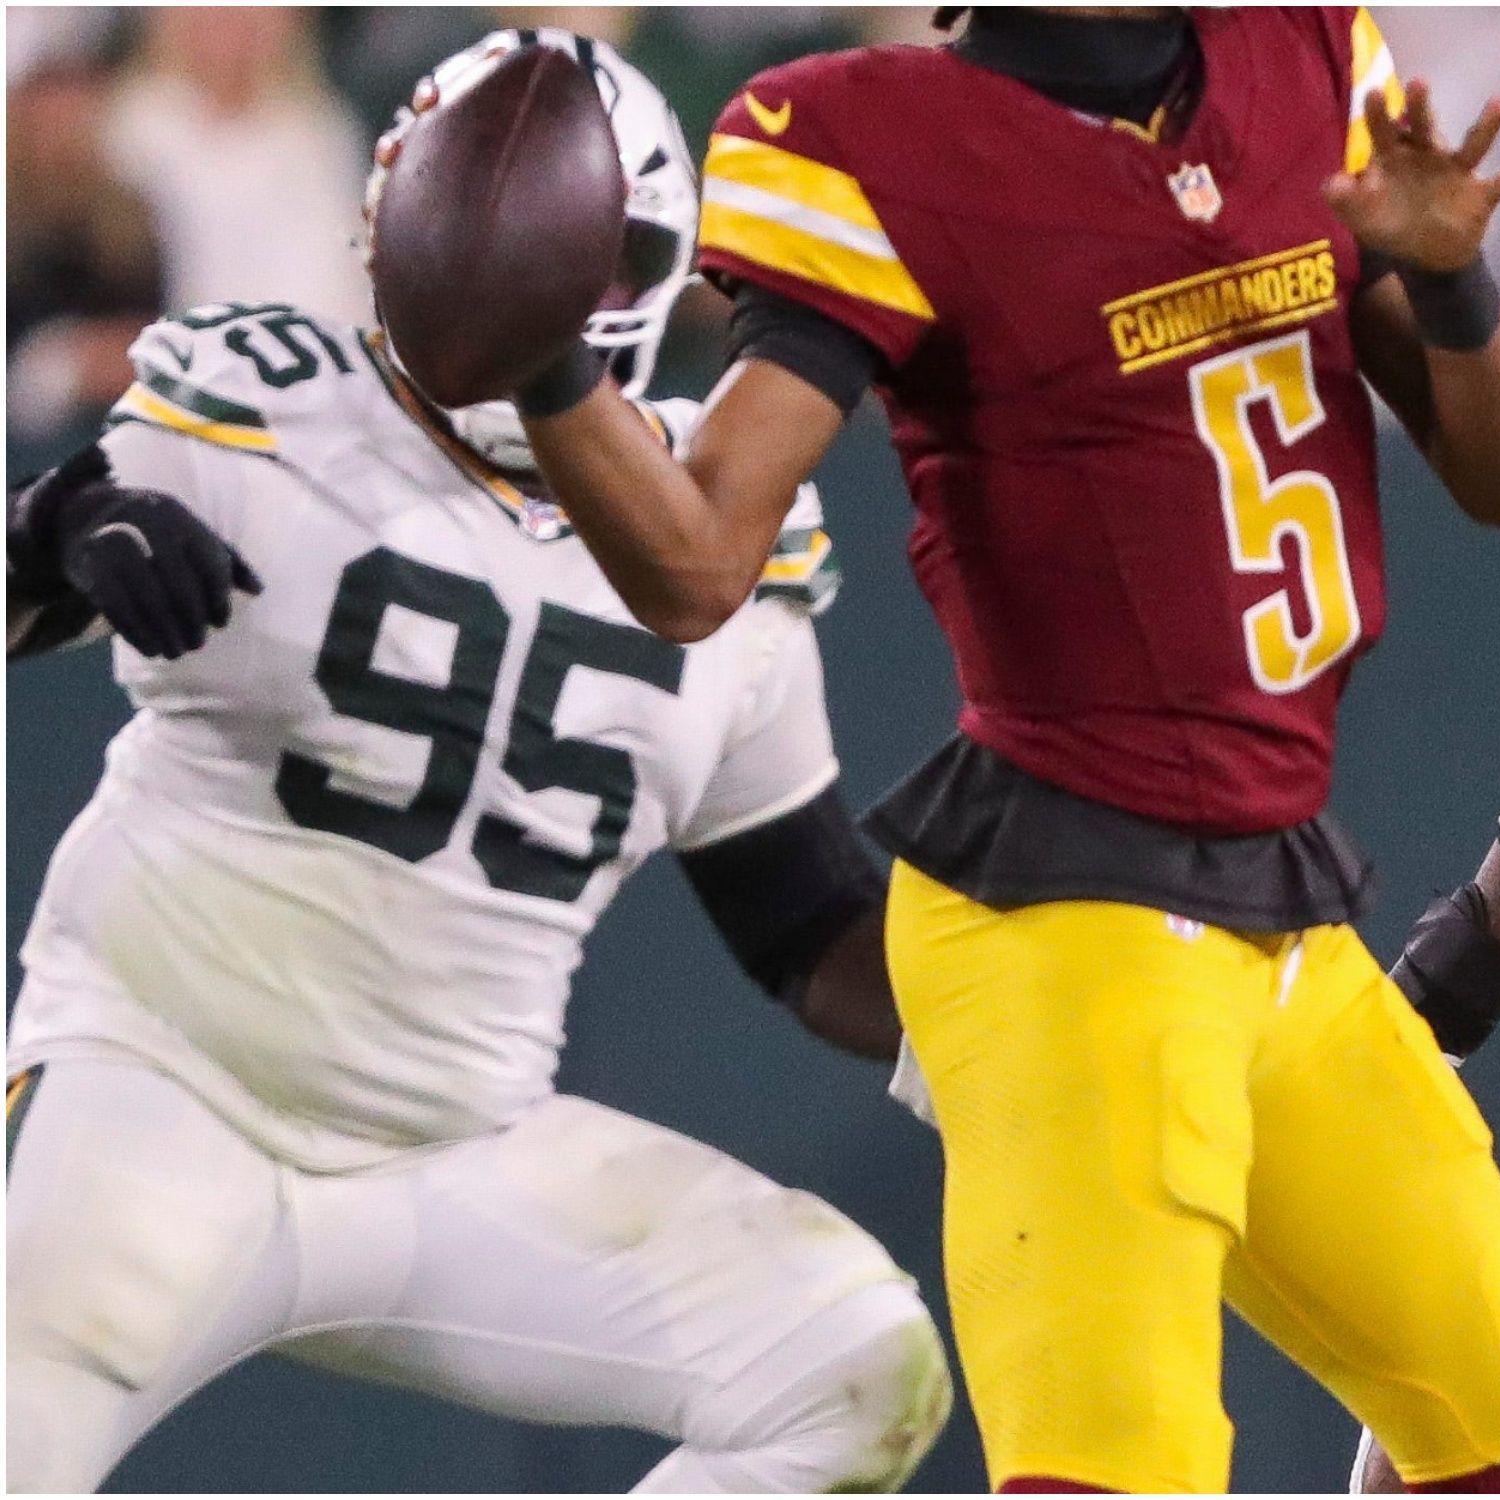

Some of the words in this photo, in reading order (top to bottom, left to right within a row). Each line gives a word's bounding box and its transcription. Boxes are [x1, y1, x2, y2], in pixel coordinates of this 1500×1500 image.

[1109, 250, 1337, 360] COMMANDERS
[1187, 329, 1361, 692] 5
[274, 545, 687, 903] 95
